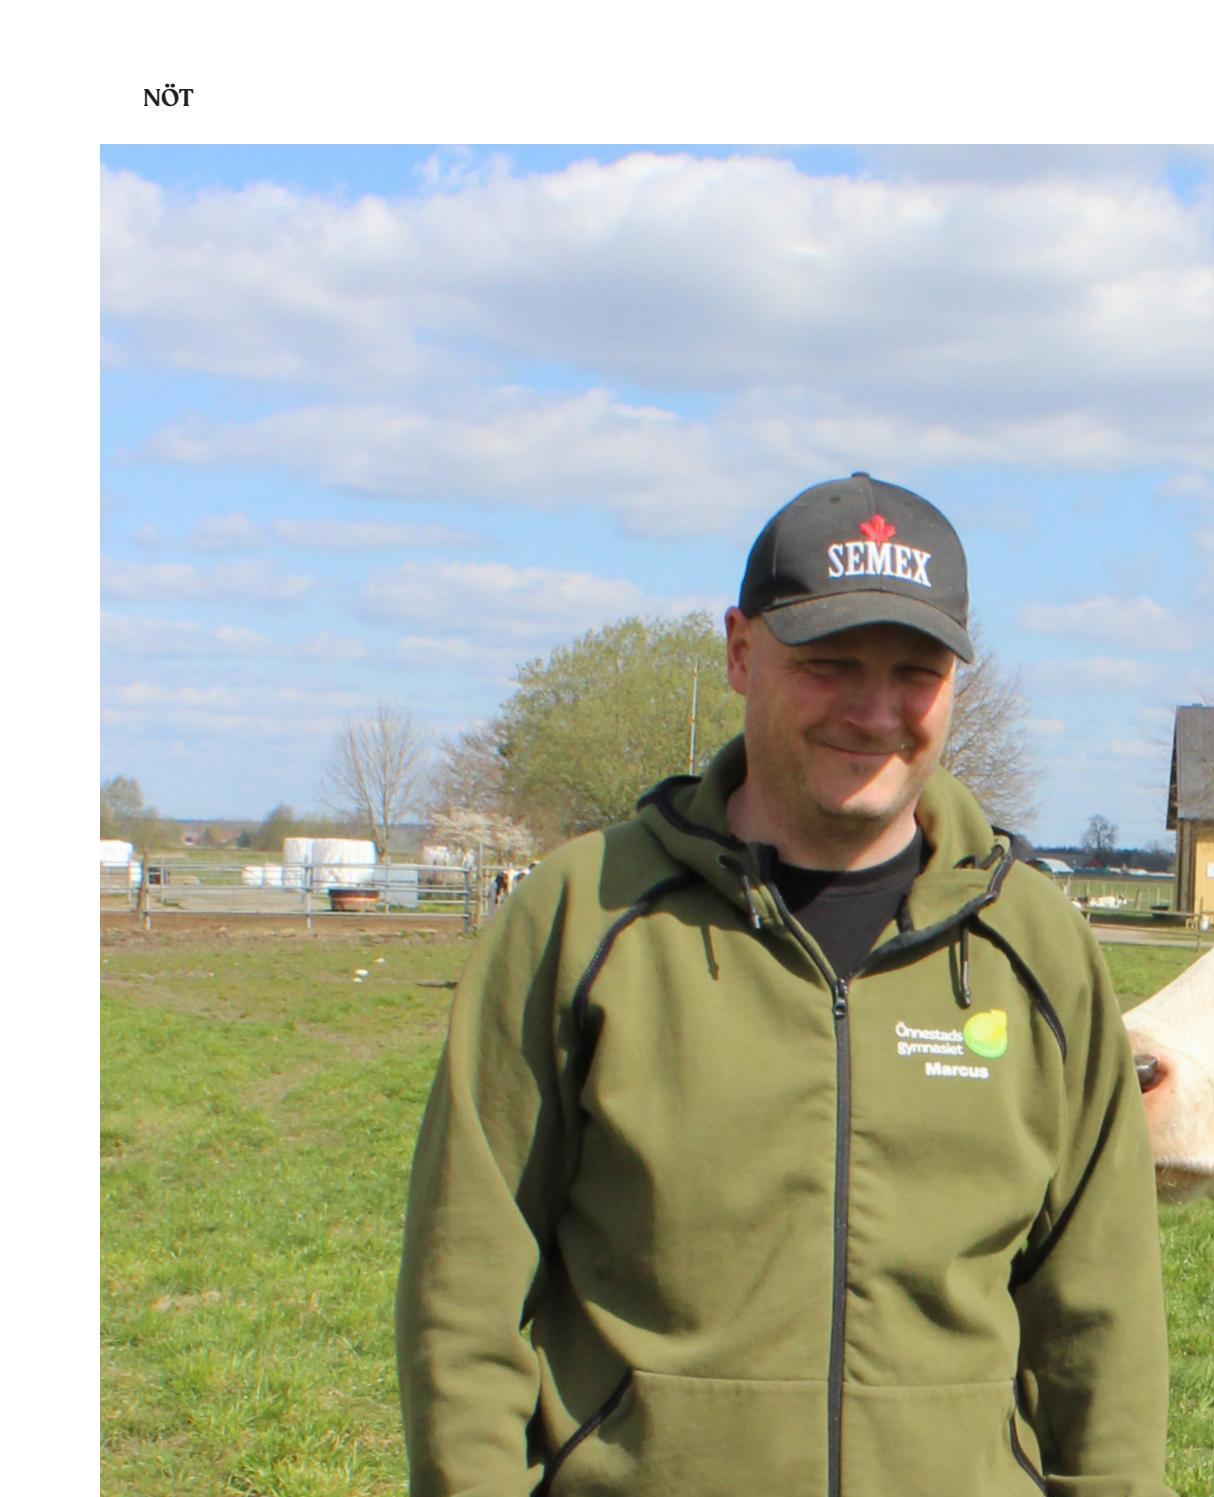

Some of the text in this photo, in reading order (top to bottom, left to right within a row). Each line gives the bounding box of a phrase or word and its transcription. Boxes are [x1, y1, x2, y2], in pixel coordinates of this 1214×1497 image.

[828, 541, 932, 588] SEMEX
[895, 1020, 964, 1042] Önnestads
[897, 1041, 964, 1056] gymnasiet
[925, 1062, 989, 1079] Marcus
